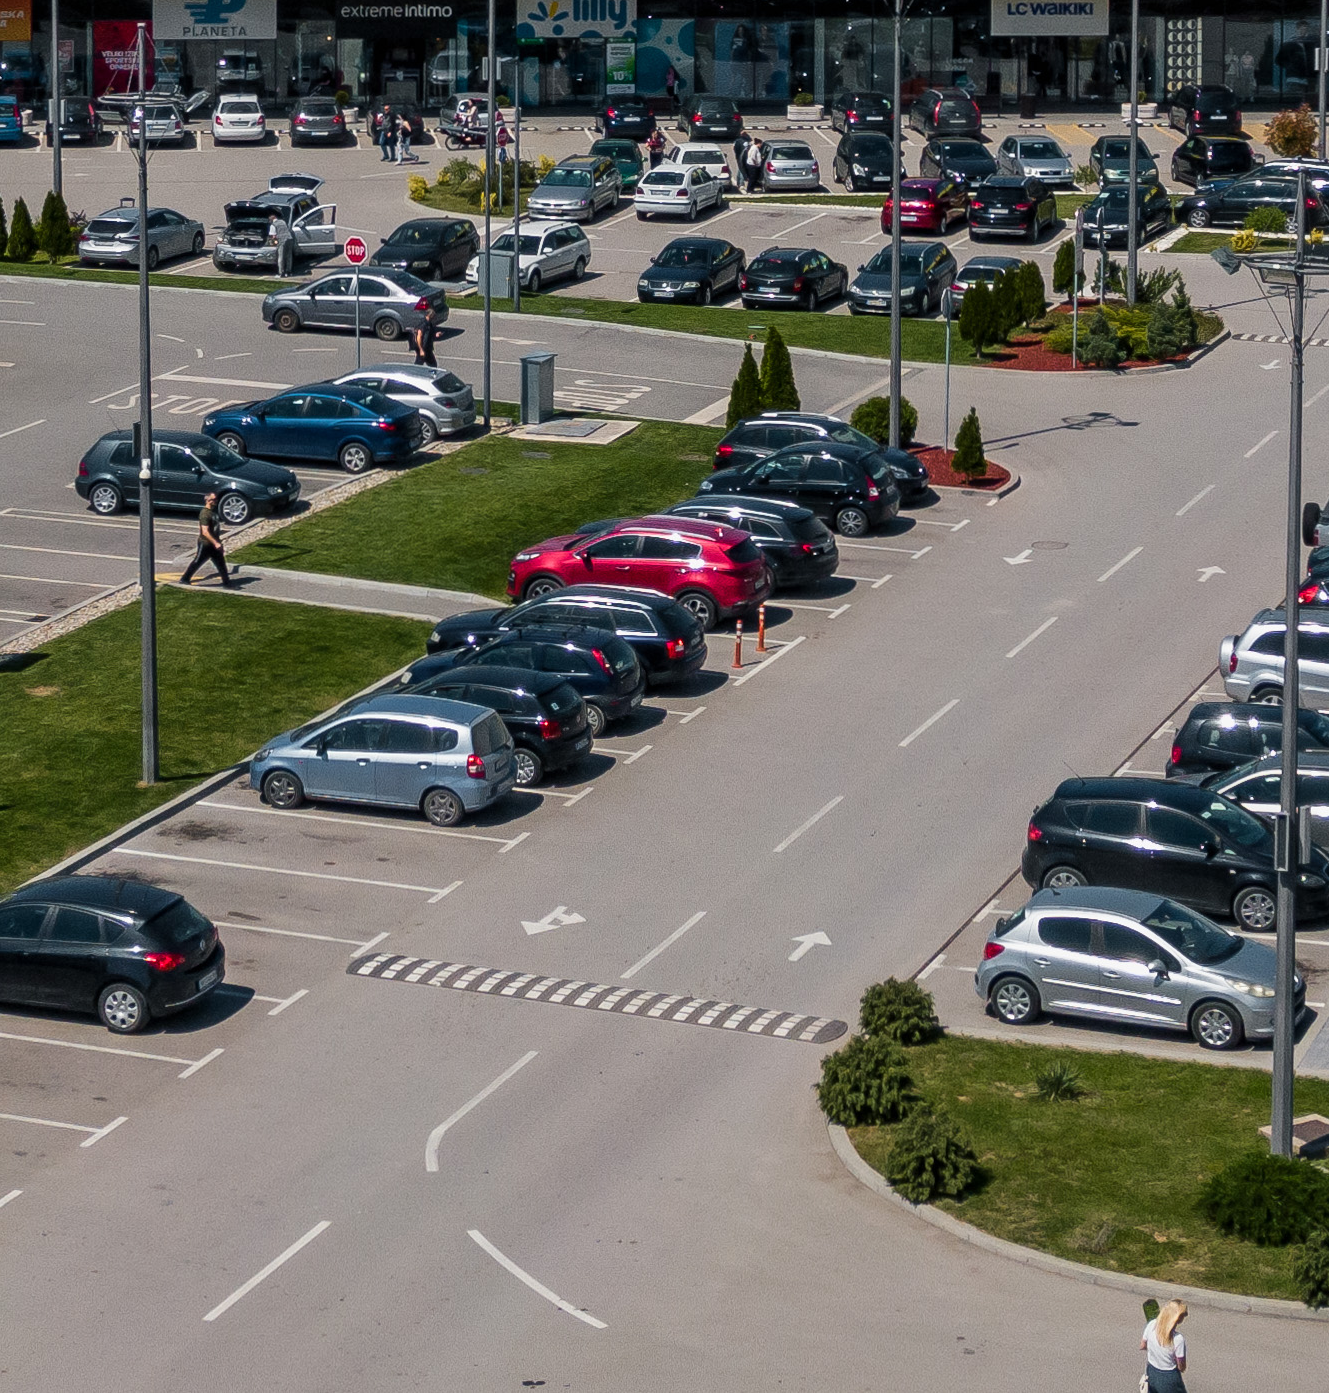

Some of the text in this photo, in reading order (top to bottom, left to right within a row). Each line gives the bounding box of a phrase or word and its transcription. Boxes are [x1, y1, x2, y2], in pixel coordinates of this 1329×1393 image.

[341, 4, 453, 17] extreme intimo
[1007, 2, 1028, 16] LC
[182, 26, 247, 37] PLANETA
[346, 244, 365, 256] STOP
